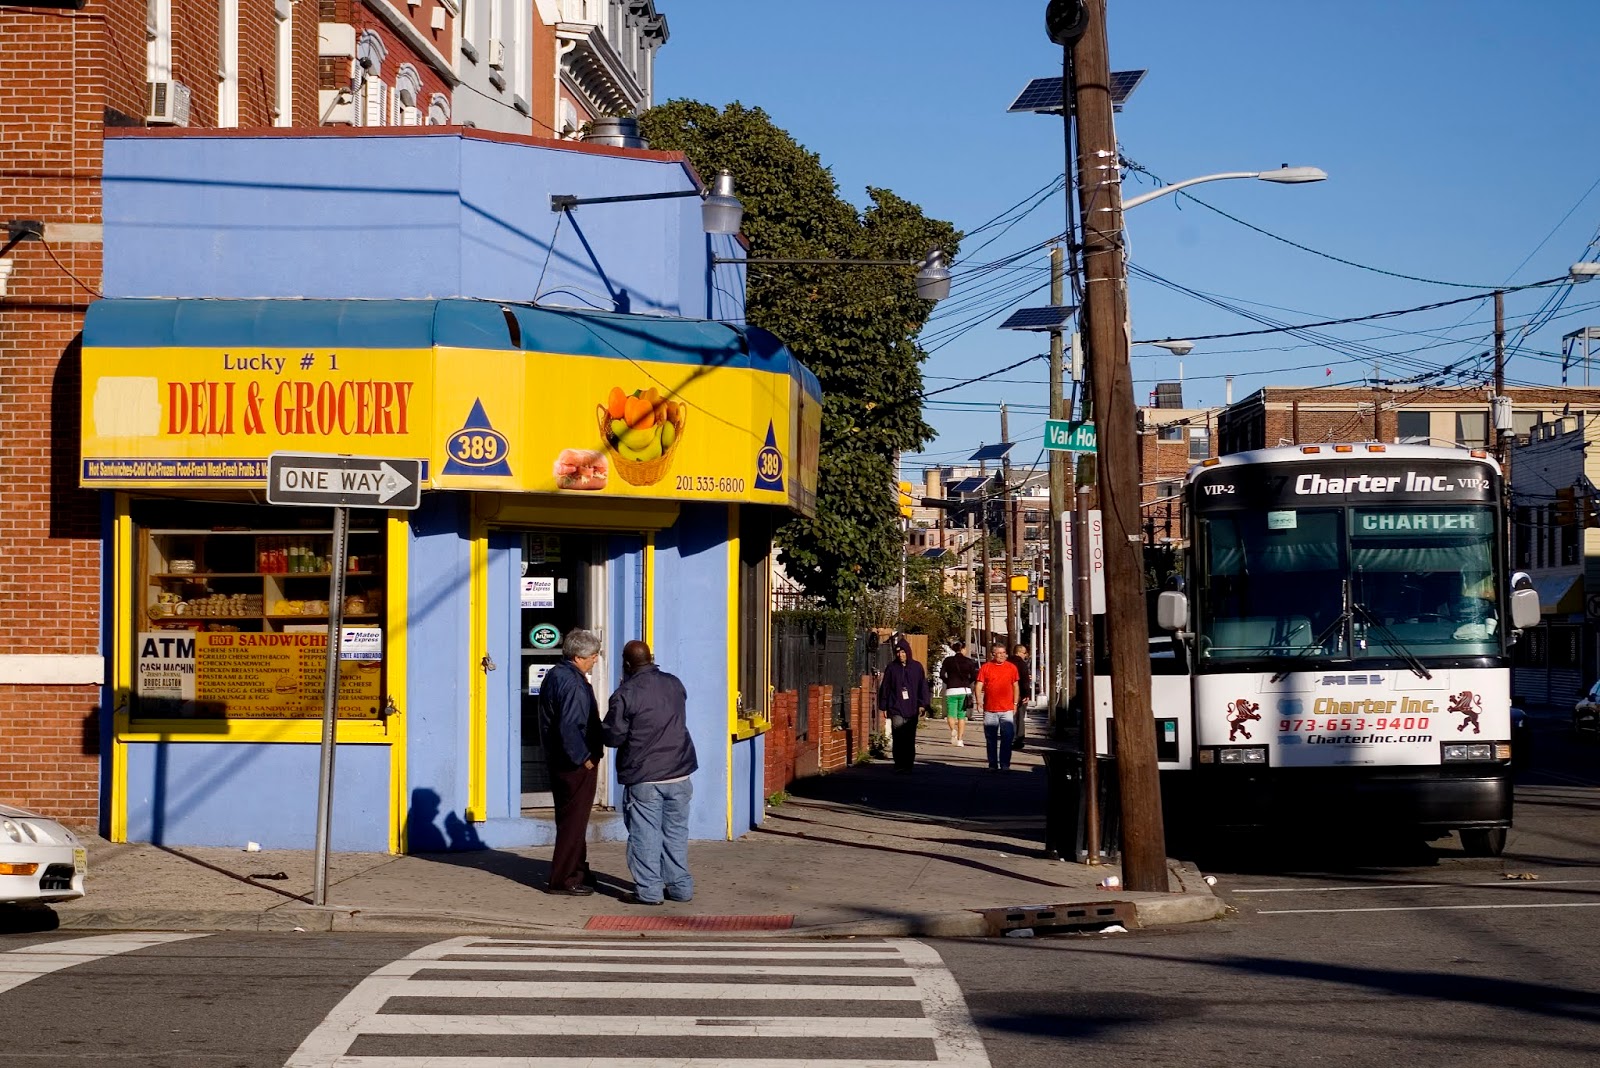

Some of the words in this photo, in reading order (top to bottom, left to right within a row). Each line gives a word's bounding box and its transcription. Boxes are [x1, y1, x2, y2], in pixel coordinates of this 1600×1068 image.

[223, 353, 286, 375] Lucky
[299, 352, 315, 370] #
[329, 353, 340, 370] 1
[167, 379, 236, 440] DELI
[243, 381, 266, 436] &
[274, 378, 414, 438] GROCERY
[1050, 425, 1073, 446] Van
[457, 435, 498, 460] 389
[761, 452, 779, 476] 389
[285, 470, 329, 490] ONE
[341, 472, 386, 492] WAY
[676, 475, 694, 491] 201
[696, 476, 745, 493] 333-6800
[1203, 484, 1235, 496] VIP-2
[1295, 473, 1400, 495] Charter
[1404, 471, 1455, 493] Inc.
[1457, 477, 1490, 490] VIP-2
[1362, 513, 1476, 531] CHARTER
[1064, 521, 1074, 561] BUS
[1093, 520, 1103, 574] STOP
[141, 637, 196, 659] ATM
[211, 636, 232, 645] HOT
[238, 634, 327, 647] SANDWICHE
[140, 662, 161, 673] CASH
[163, 662, 195, 674] MACHIN
[1313, 698, 1397, 715] Charter
[1400, 696, 1440, 714] Inc.
[1279, 717, 1430, 732] 973-653-9400
[1306, 733, 1433, 745] CharterInc.com
